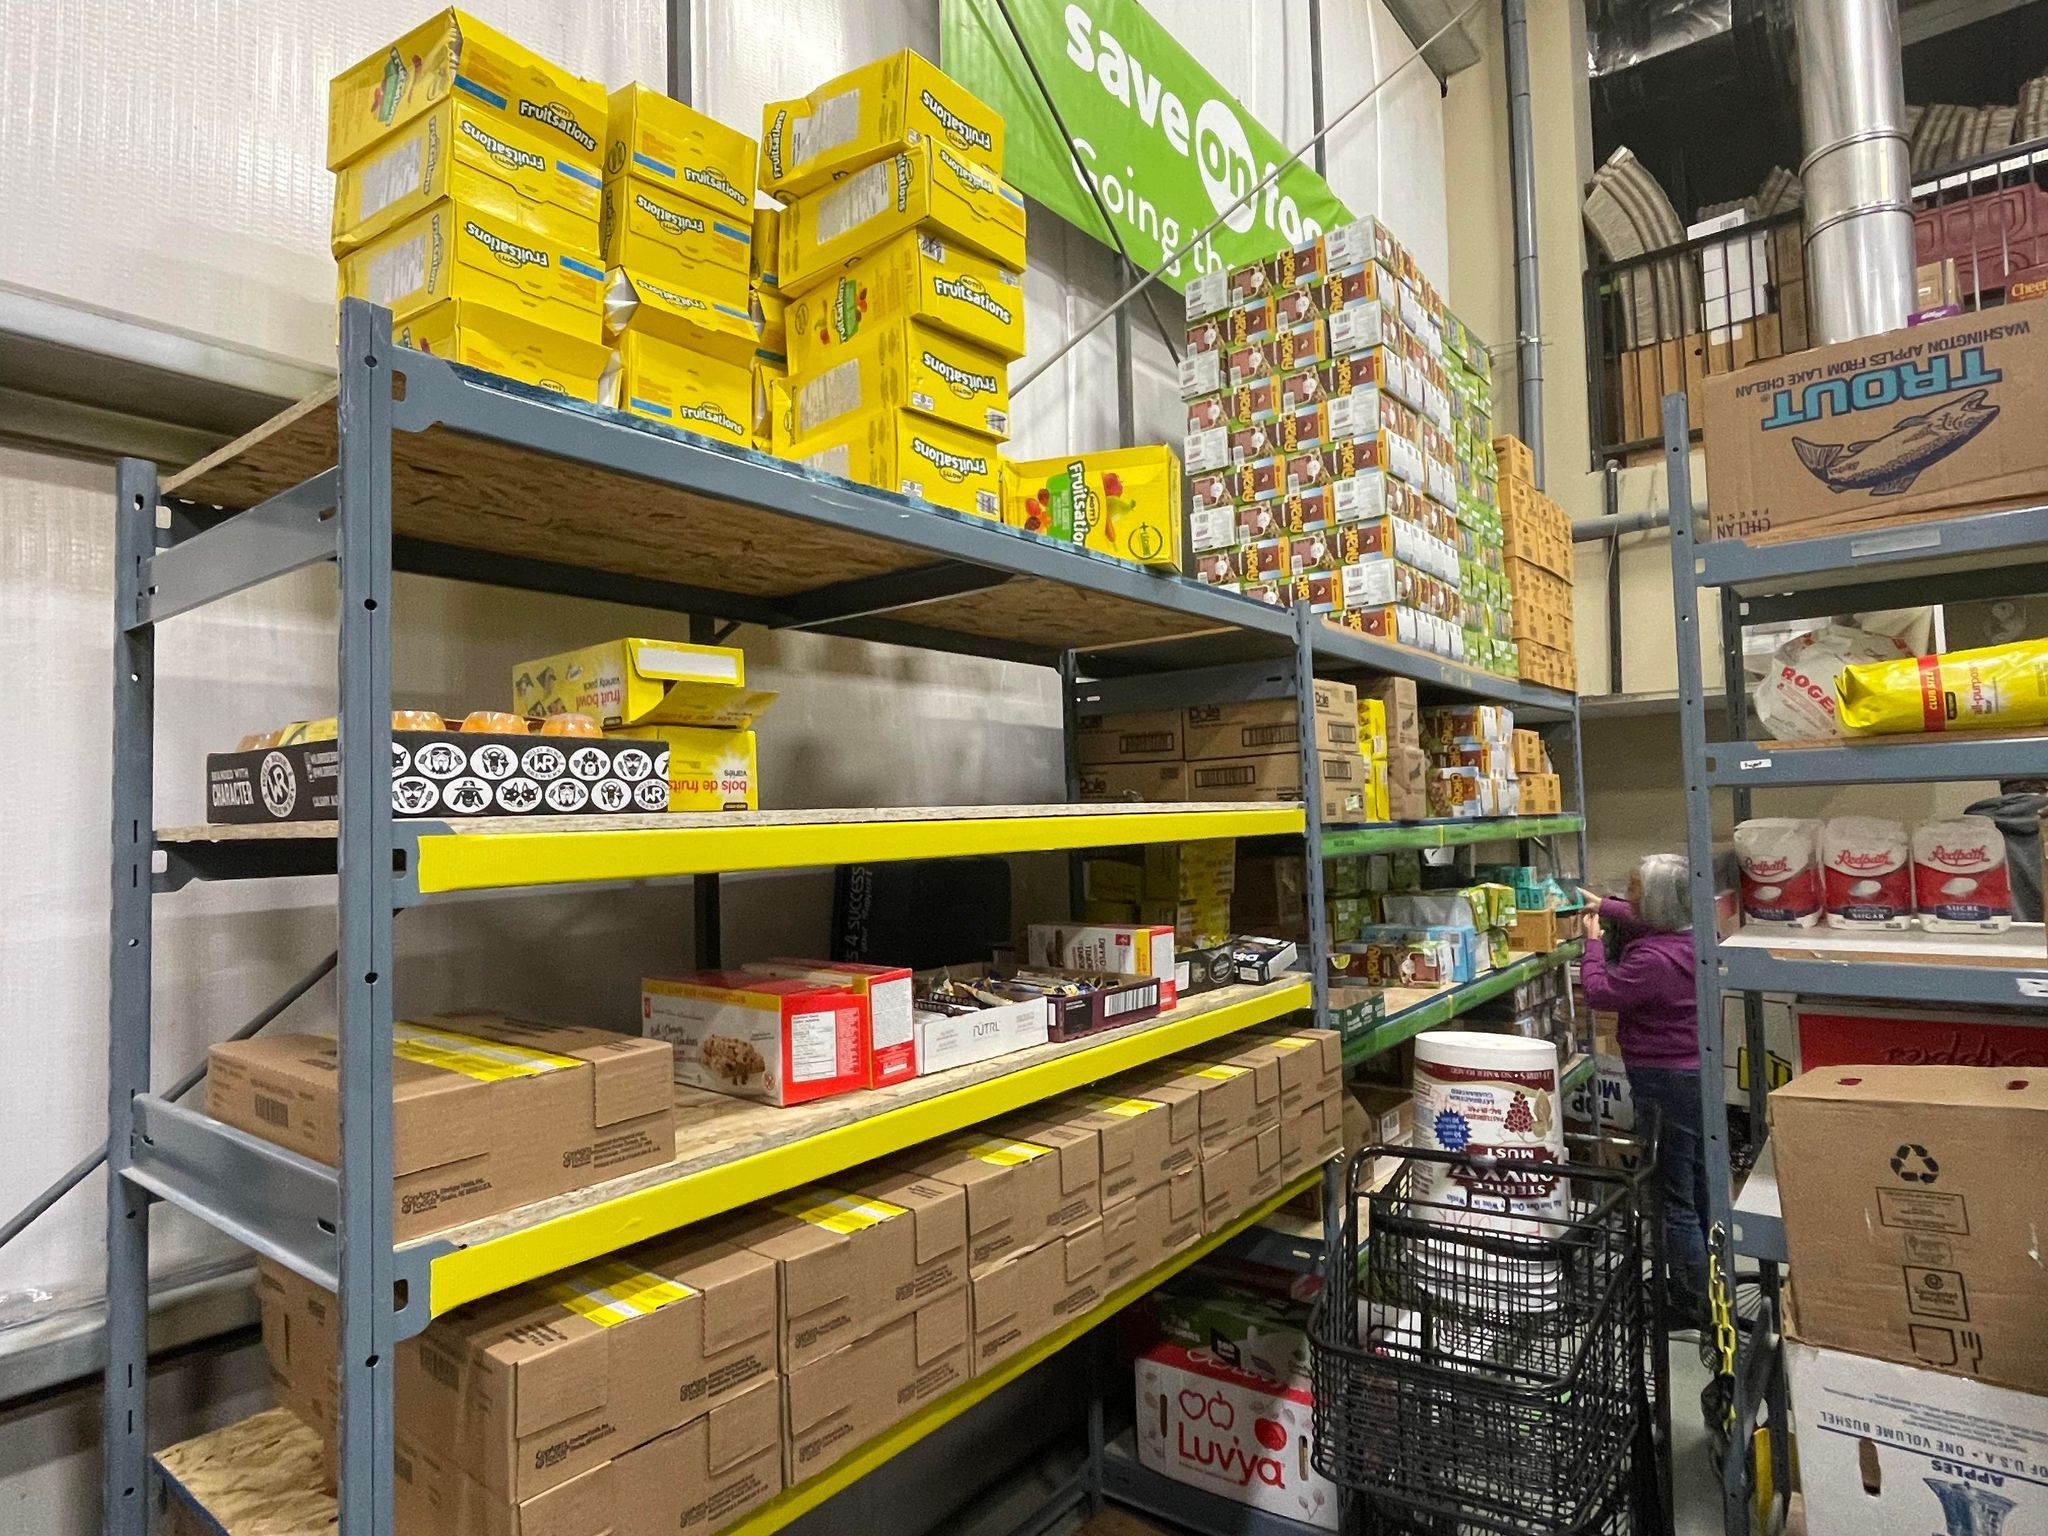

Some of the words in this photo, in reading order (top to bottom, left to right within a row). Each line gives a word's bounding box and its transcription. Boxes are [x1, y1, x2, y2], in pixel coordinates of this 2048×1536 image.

[920, 90, 992, 151] Fruitsations
[1064, 3, 1190, 157] save
[1200, 127, 1254, 210] on
[519, 99, 596, 152] Fruitsations
[461, 120, 546, 172] Fruitsations
[771, 109, 786, 180] Fruitsations
[685, 167, 747, 206] Fruitsations
[637, 195, 704, 233] Fruitsations
[1071, 137, 1181, 279] Going
[1192, 222, 1236, 275] th
[466, 222, 549, 268] Fruitsations
[934, 277, 1011, 325] Fruitsations
[1927, 321, 2031, 353] WASHINGTON
[1827, 357, 1867, 377] FROM
[1870, 344, 1923, 366] APPLES
[924, 351, 997, 394] Fruitsations
[1789, 368, 1823, 386] LAKE
[1735, 376, 1785, 398] CHELAN
[1761, 346, 2003, 431] TROUT
[681, 405, 743, 436] Fruitsations
[913, 437, 987, 475] Fruitsations
[1717, 517, 1771, 539] CHELAN
[575, 694, 599, 711] bowl
[600, 689, 621, 707] fruit
[1781, 666, 1836, 716] ROGE
[533, 755, 555, 771] WR
[211, 781, 255, 807] CHARACTER
[268, 769, 289, 803] WR
[644, 787, 664, 803] WR
[702, 780, 719, 791] de
[722, 780, 747, 793] bols
[1928, 845, 1990, 867] Redpath
[1486, 1148, 1534, 1159] MUST
[1472, 1183, 1546, 1195] STERILE
[1819, 1410, 1871, 1434] BUSHEL
[1874, 1425, 1933, 1448] VOLUME
[1936, 1439, 1967, 1457] ONE
[1178, 1421, 1286, 1490] Luvya
[1931, 1459, 2006, 1487] APPLES
